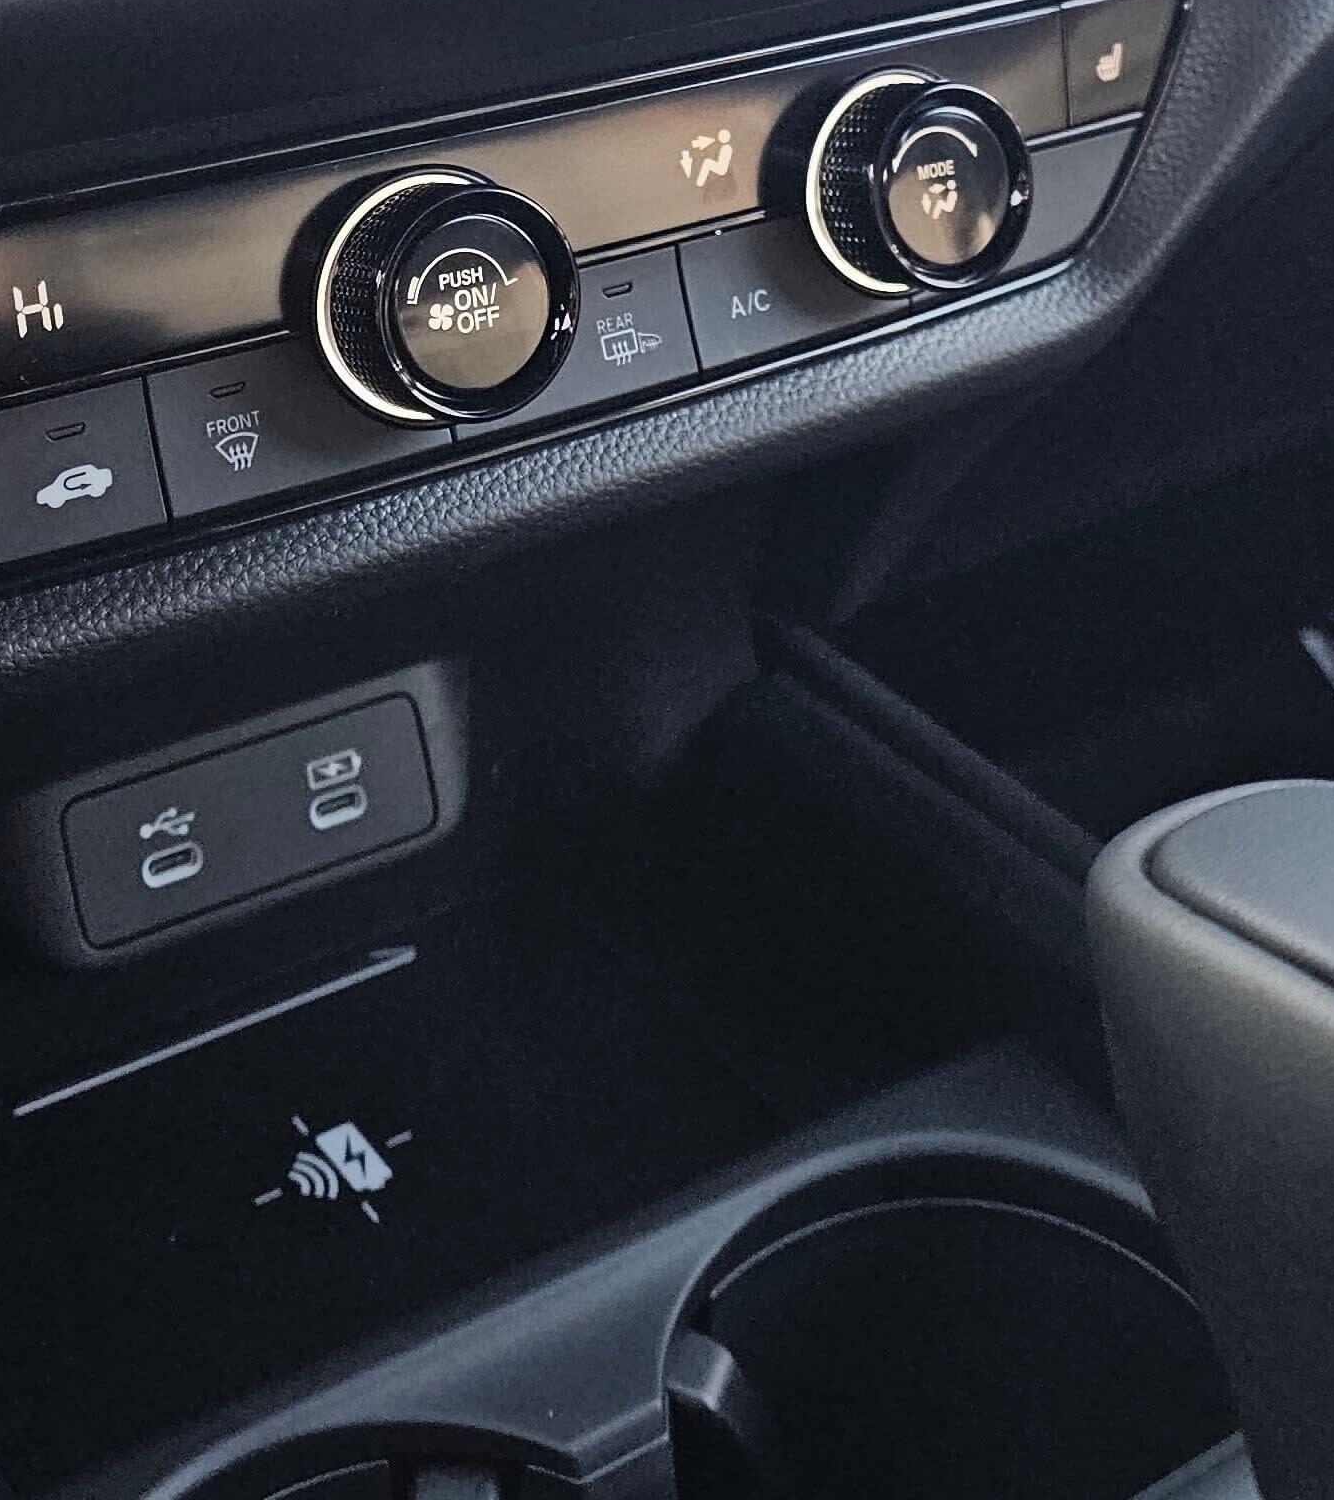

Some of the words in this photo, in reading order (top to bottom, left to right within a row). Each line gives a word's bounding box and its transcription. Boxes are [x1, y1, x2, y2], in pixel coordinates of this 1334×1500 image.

[916, 159, 957, 181] MODE
[438, 266, 485, 291] PUSH
[453, 281, 498, 312] ON/
[729, 289, 772, 320] A/C
[456, 304, 501, 334] OFF
[596, 311, 635, 335] REAR
[205, 409, 262, 440] FRONT
